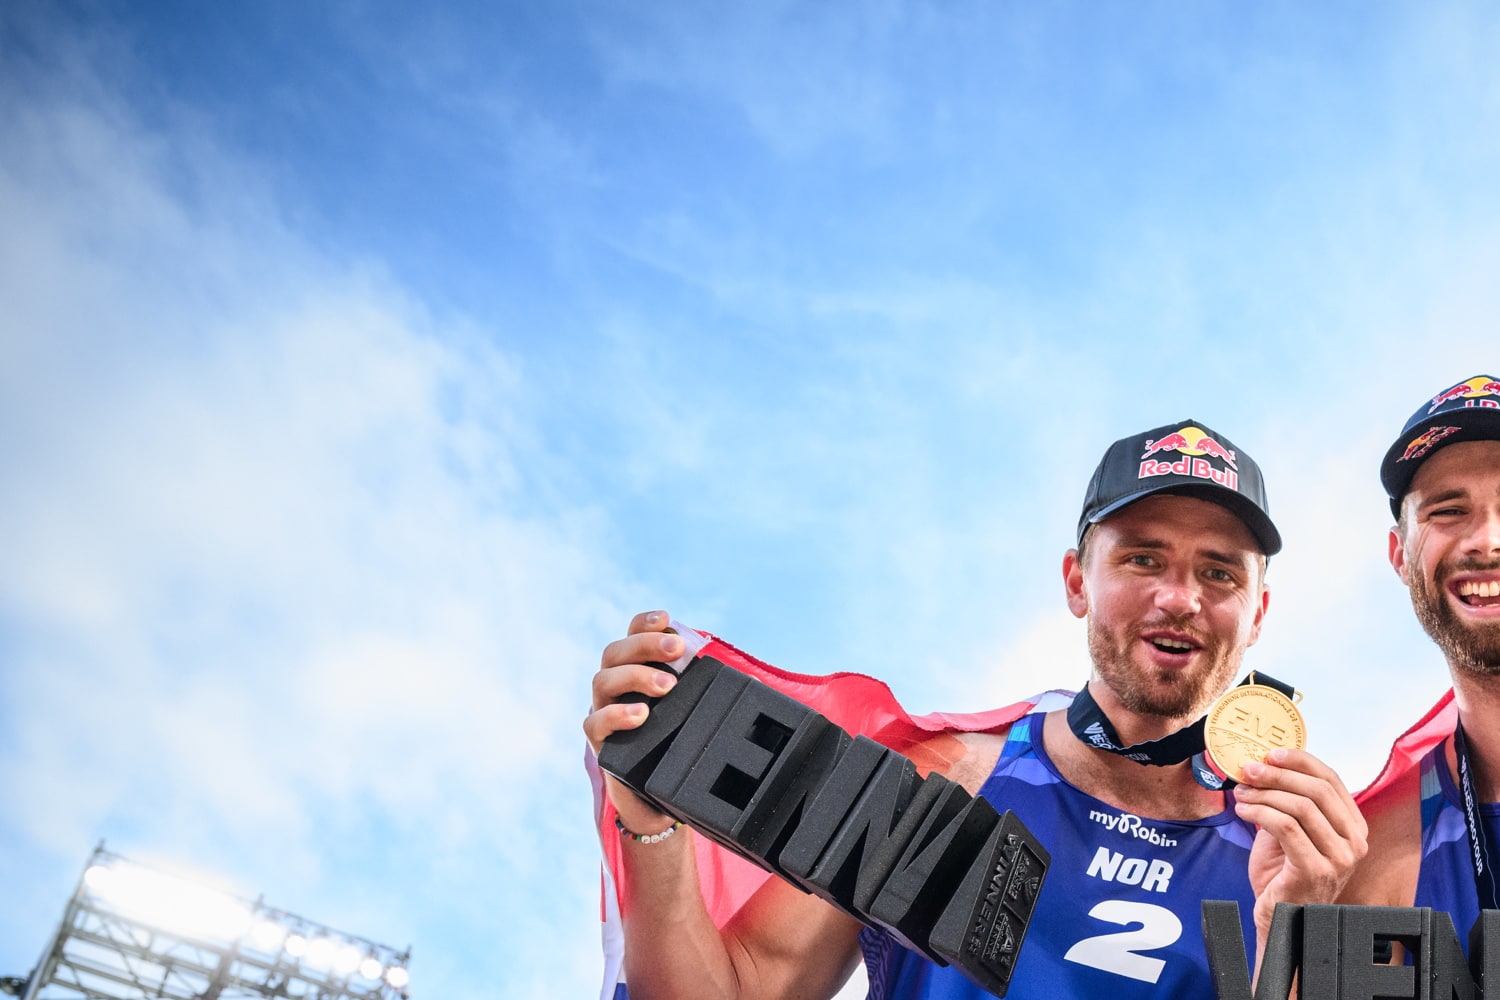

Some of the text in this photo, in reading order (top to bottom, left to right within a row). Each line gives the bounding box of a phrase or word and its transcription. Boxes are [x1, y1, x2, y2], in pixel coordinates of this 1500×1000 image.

[1138, 456, 1238, 491] Red Bull
[1089, 810, 1178, 847] myRobin
[1086, 846, 1174, 893] NOR
[1064, 900, 1182, 984] 2
